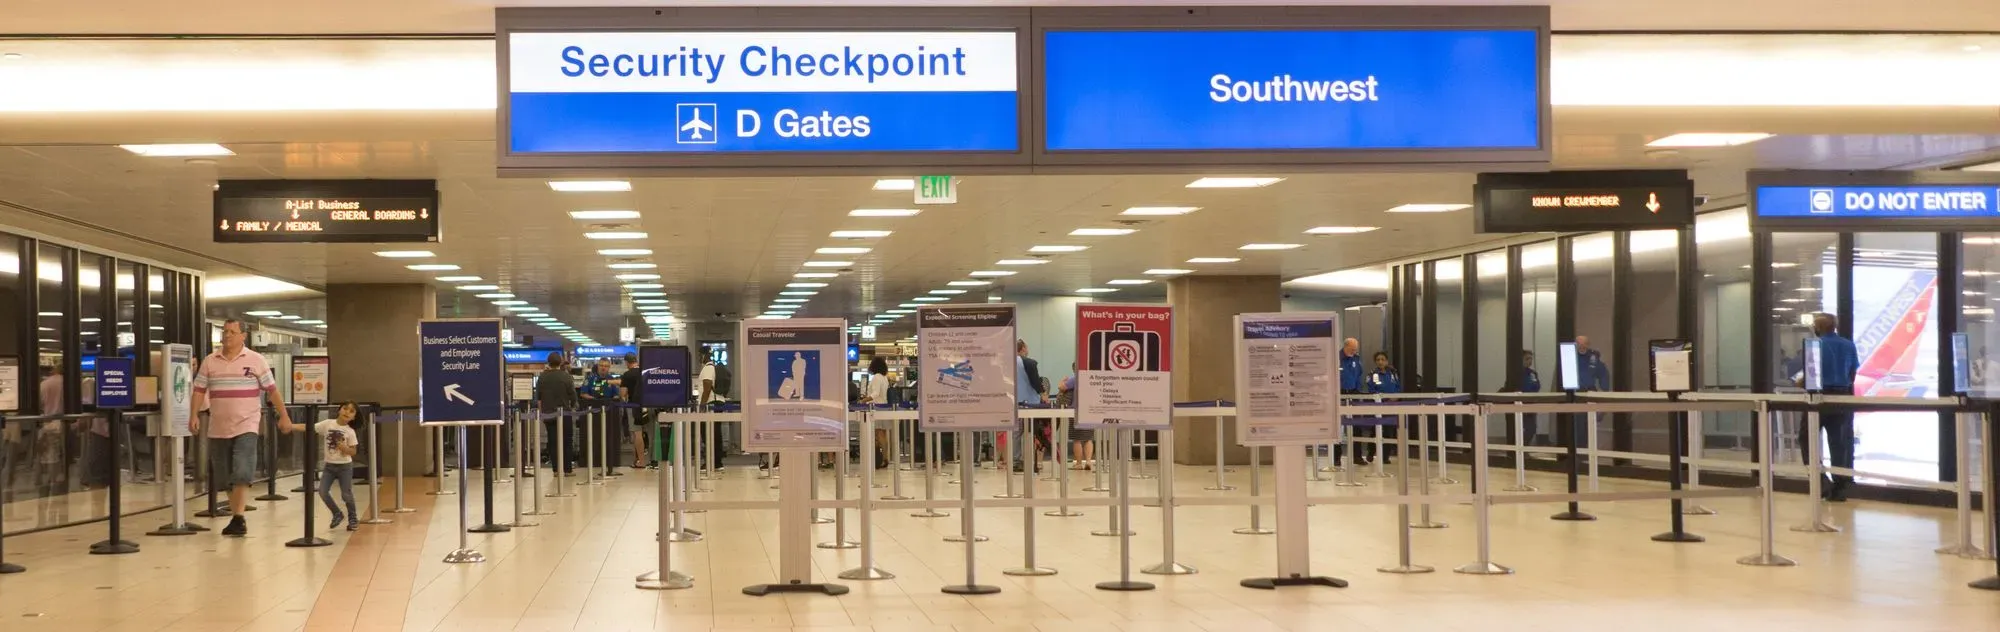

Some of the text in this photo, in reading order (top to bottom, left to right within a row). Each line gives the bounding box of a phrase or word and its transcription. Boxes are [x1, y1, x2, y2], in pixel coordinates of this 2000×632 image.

[560, 45, 967, 83] Security Checkpoint
[1209, 73, 1379, 102] Southwest
[736, 109, 871, 138] D Gates
[921, 175, 951, 198] EXIT
[286, 200, 360, 209] A-List Business
[1532, 196, 1620, 207] KNOWN CREWMEMBER
[1845, 191, 1987, 210] DO NOT ENTER
[331, 211, 416, 220] GENERAL BOARDING
[236, 221, 270, 231] FAMILY
[286, 221, 323, 231] MEDICAL
[1082, 310, 1170, 321] What's in your bag?
[1857, 280, 1923, 359] OUTHWEST
[423, 336, 497, 345] Business Select Customers
[440, 348, 480, 359] and Employee
[442, 361, 480, 371] Security Lane
